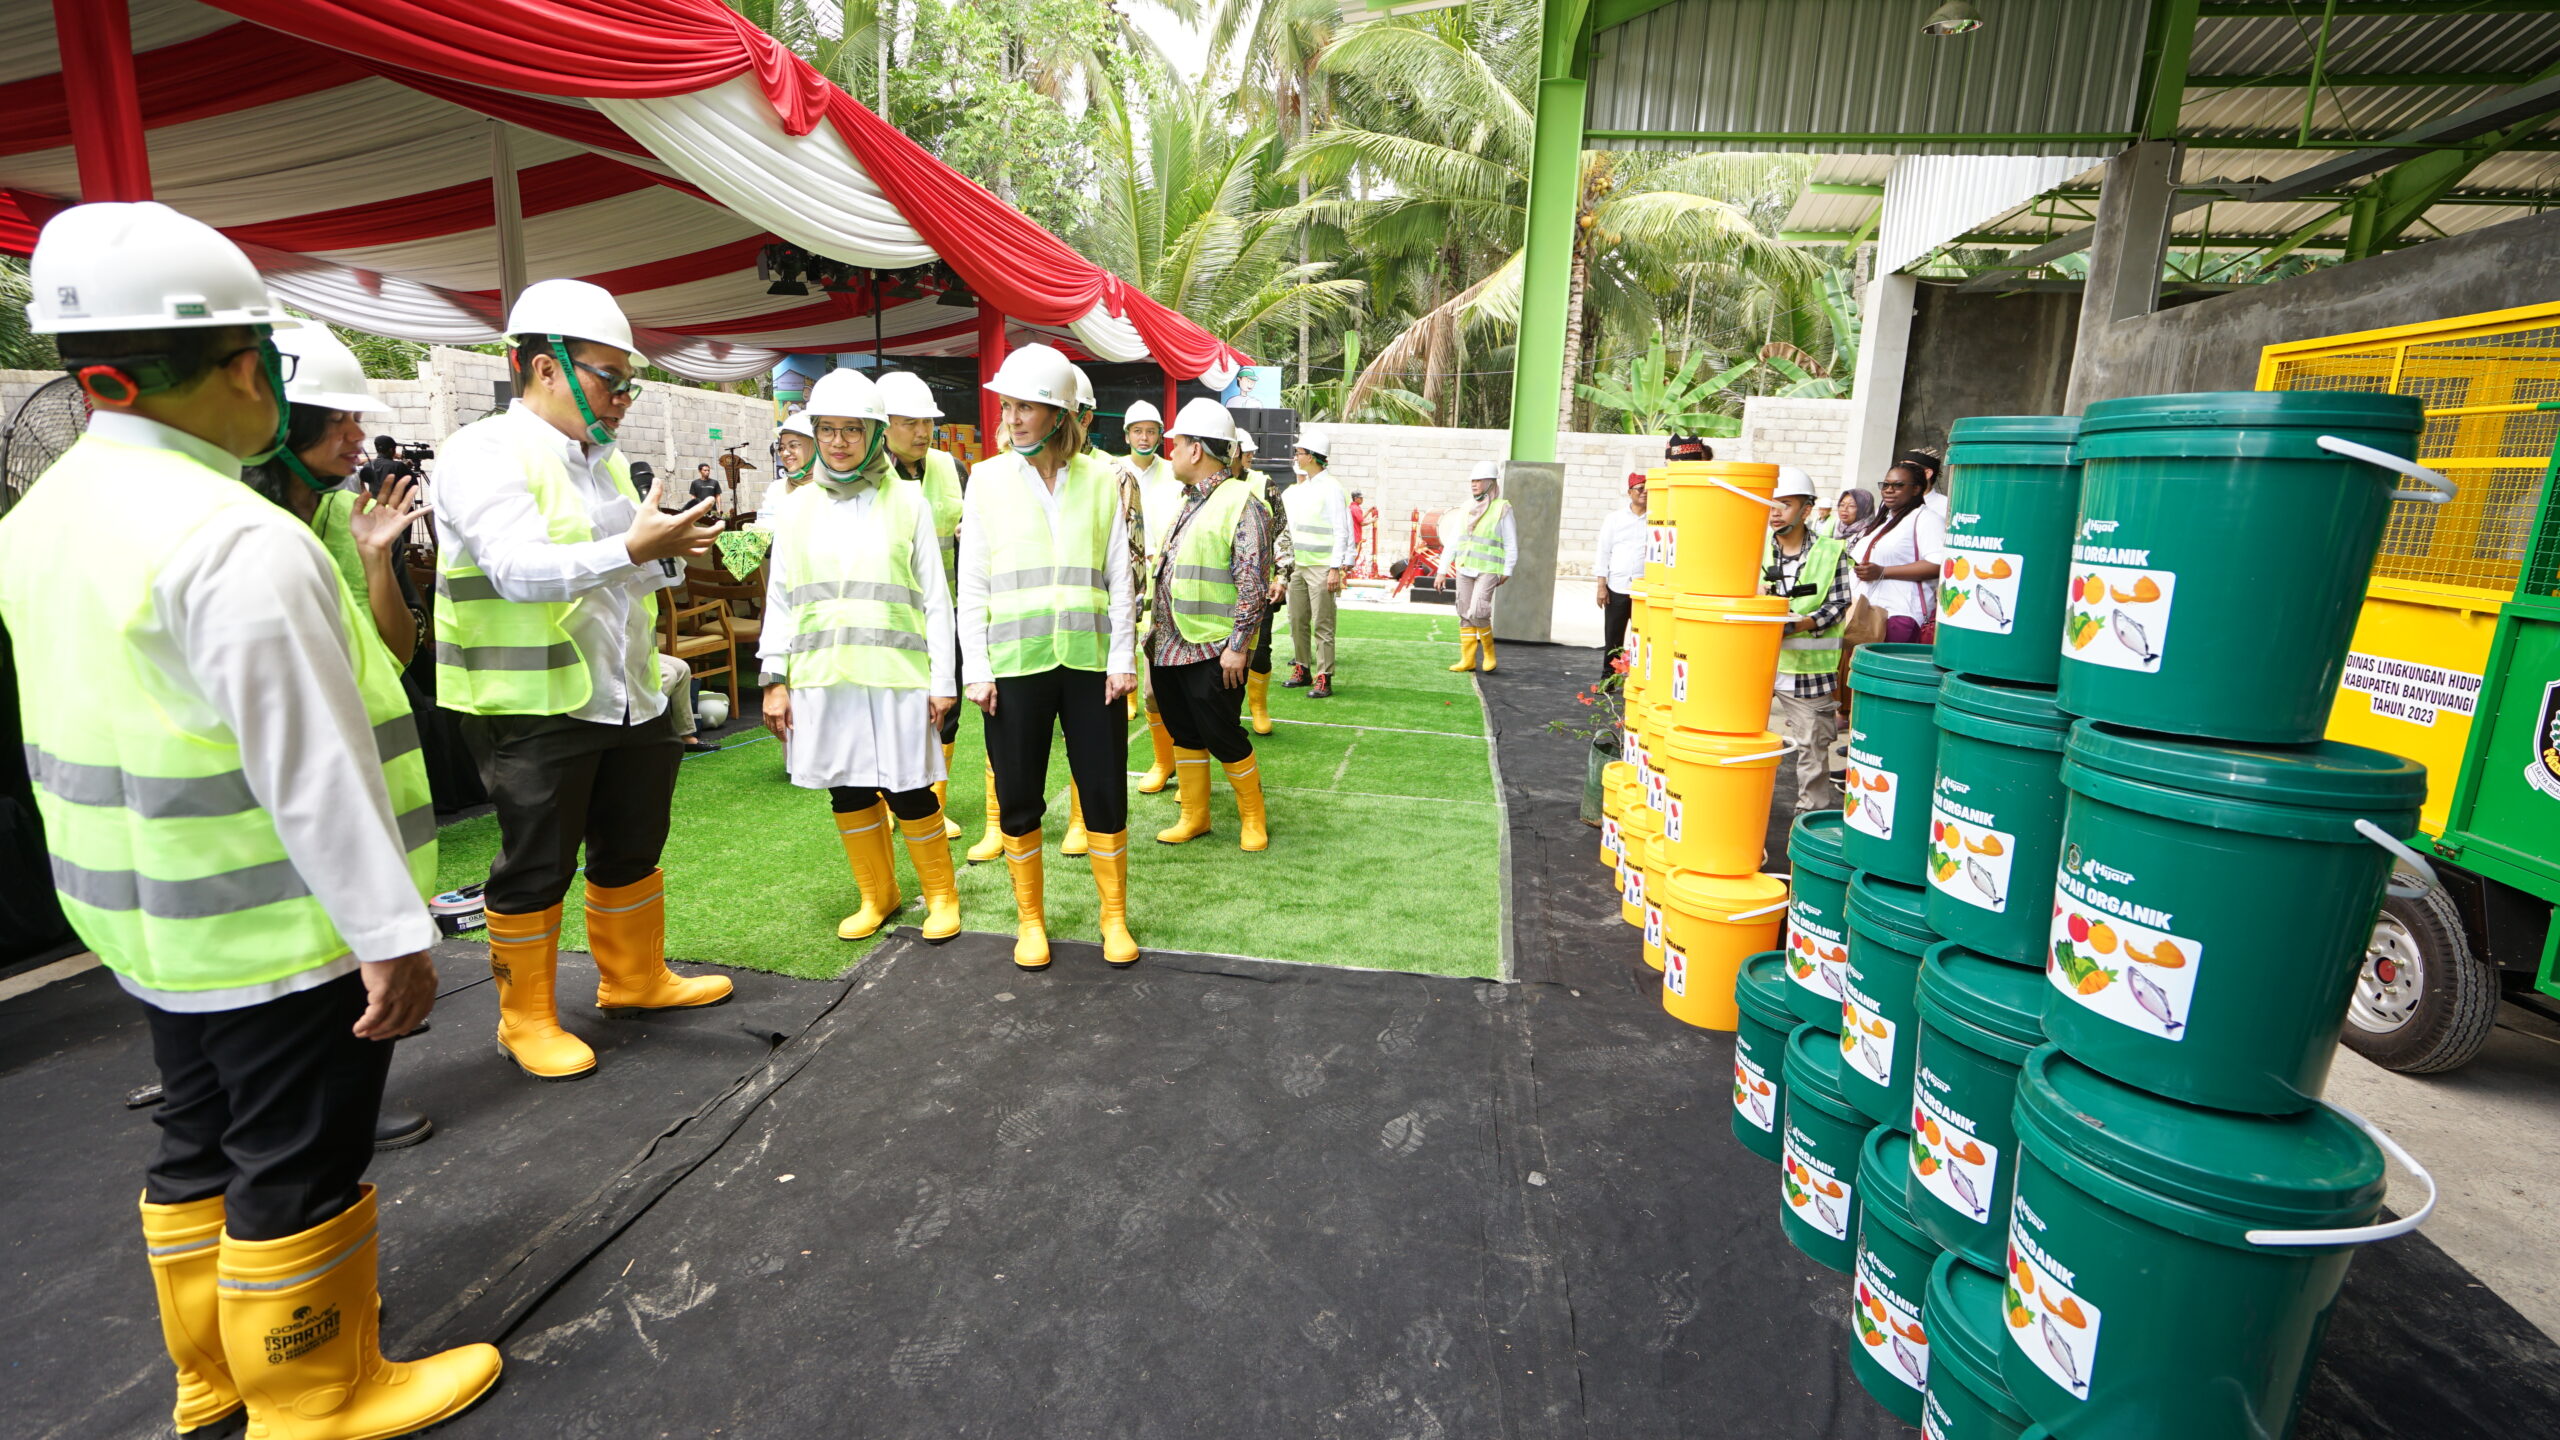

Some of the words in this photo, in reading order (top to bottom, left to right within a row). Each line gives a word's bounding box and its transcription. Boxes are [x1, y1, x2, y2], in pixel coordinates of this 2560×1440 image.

[1953, 533, 2005, 551] ORGANIK
[2083, 545, 2151, 567] ORGANIK
[2346, 654, 2376, 672] DINAS
[2376, 660, 2447, 686] LINGKUNGAN
[2447, 675, 2483, 693] HIDUP
[2344, 672, 2400, 696] KABUPATEN
[2401, 684, 2475, 713] BANYUWANGI
[2373, 697, 2407, 717] TAHUN
[2407, 706, 2435, 724] 2023
[1943, 797, 1996, 828] ORGANIK
[2095, 861, 2136, 885] Hijau
[2086, 887, 2174, 931] ORGANIK
[1800, 917, 1842, 942] ORGANIK
[1923, 1089, 1977, 1136] ORGANIK
[1794, 1142, 1837, 1178] ORGANIK
[2017, 1222, 2076, 1290] ORGANIK
[1869, 1270, 1920, 1319] ORGANIK
